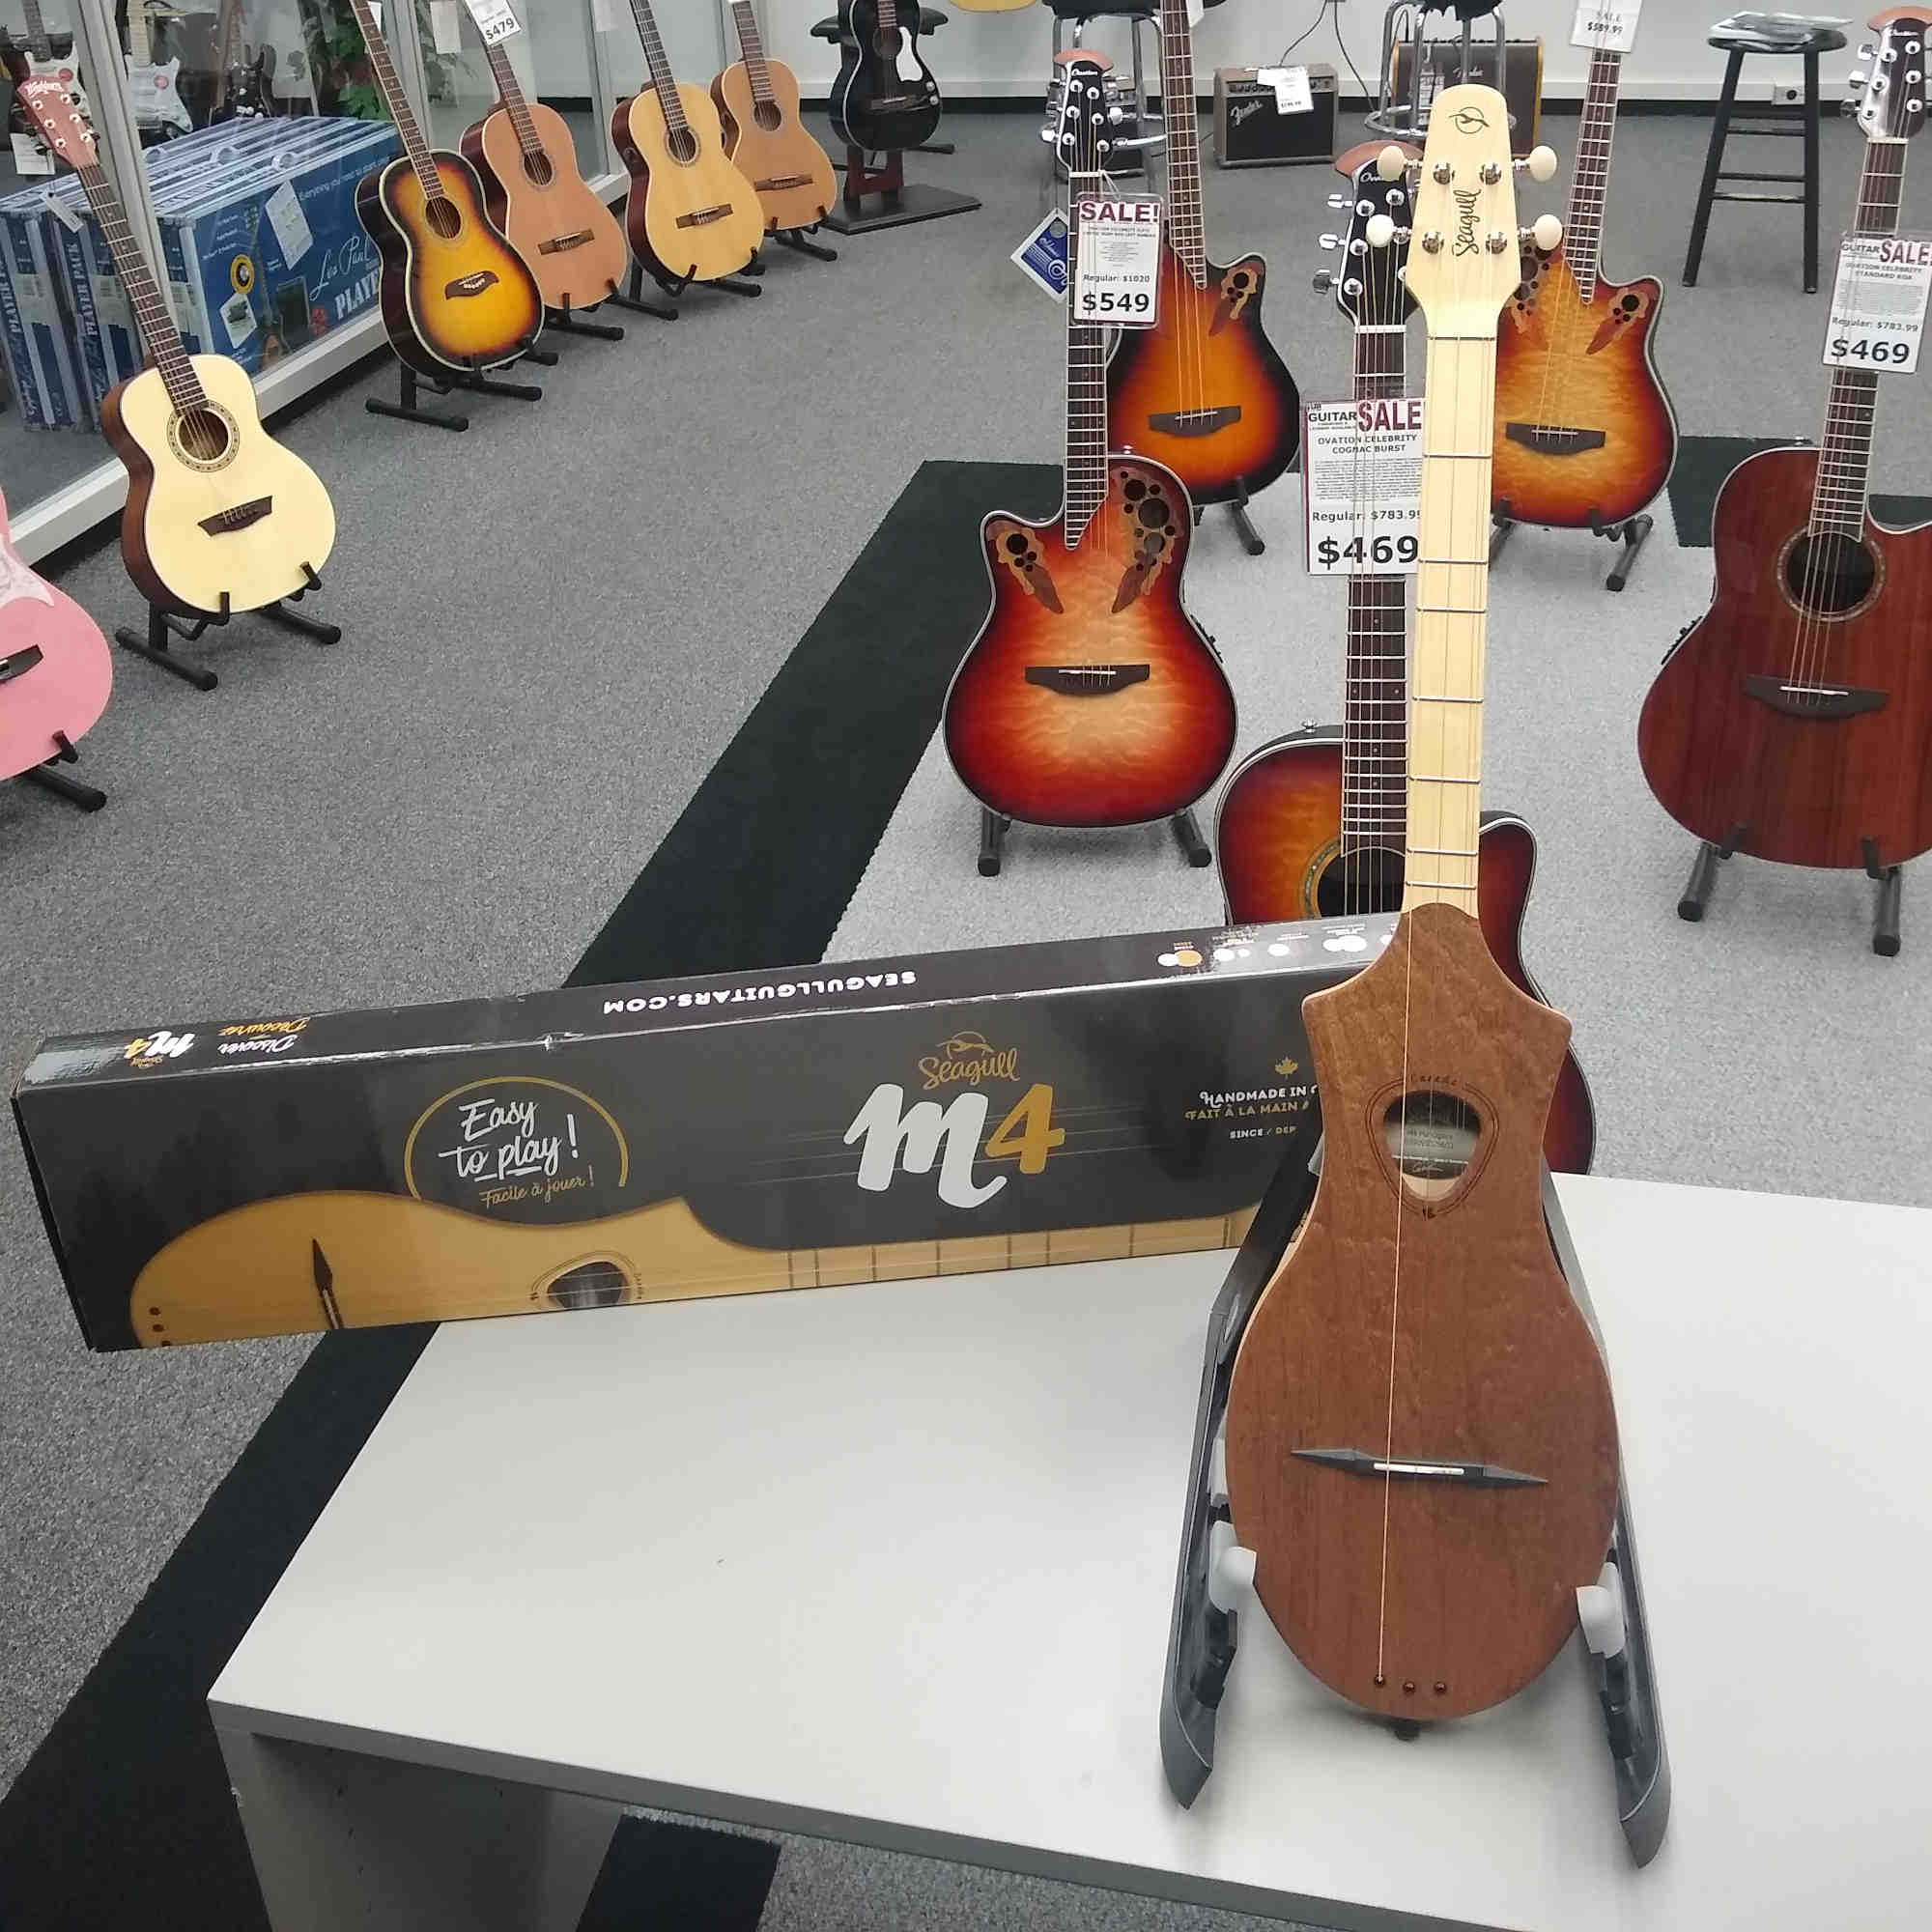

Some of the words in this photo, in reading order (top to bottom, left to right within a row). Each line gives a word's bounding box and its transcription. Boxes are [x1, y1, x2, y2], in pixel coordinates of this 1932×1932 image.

[1080, 202, 1159, 223] SALE!
[1452, 189, 1482, 257] Seagull
[1083, 292, 1151, 315] $549
[1832, 336, 1910, 364] $469
[1308, 412, 1357, 422] GUITAR
[1318, 437, 1362, 445] OVATION
[1364, 434, 1417, 442] CELEBRITY
[1332, 445, 1372, 454] COGNAC
[1318, 535, 1418, 571] $469
[603, 970, 917, 1015] SEAGULLGUITARS.COM
[216, 1034, 298, 1055] Discover
[919, 1046, 1021, 1091] Seagull
[1199, 1086, 1286, 1109] HANDMADE
[1290, 1085, 1307, 1097] IN
[458, 1098, 539, 1142] Easy
[1184, 1108, 1222, 1121] FAIT
[1238, 1105, 1256, 1116] LA
[1260, 1101, 1298, 1114] MAIN
[1229, 1127, 1264, 1139] SINCE
[438, 1143, 491, 1178] to
[478, 1184, 528, 1209] Facile
[530, 1180, 544, 1197] à
